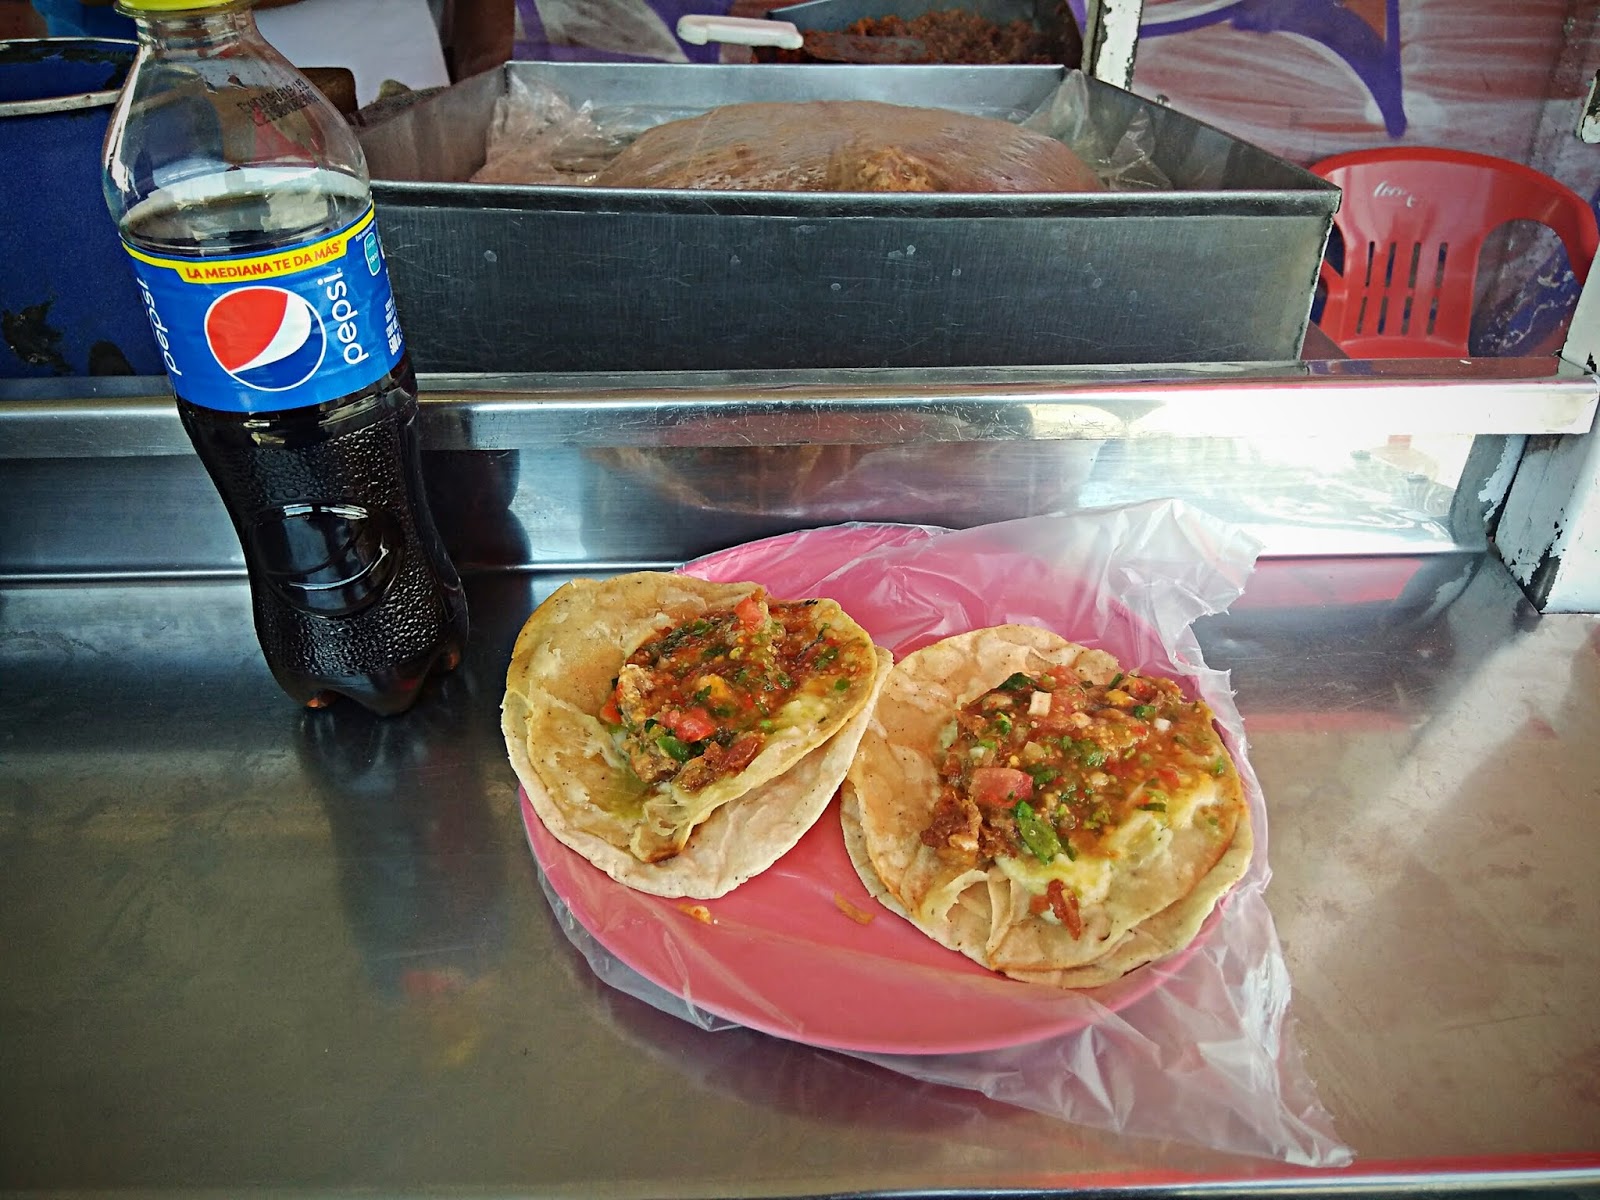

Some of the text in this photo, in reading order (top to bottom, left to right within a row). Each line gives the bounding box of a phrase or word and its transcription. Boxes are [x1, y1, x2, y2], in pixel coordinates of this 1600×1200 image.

[185, 241, 341, 279] LA MEDIANA TE DA MÁS
[317, 271, 370, 365] pepsi
